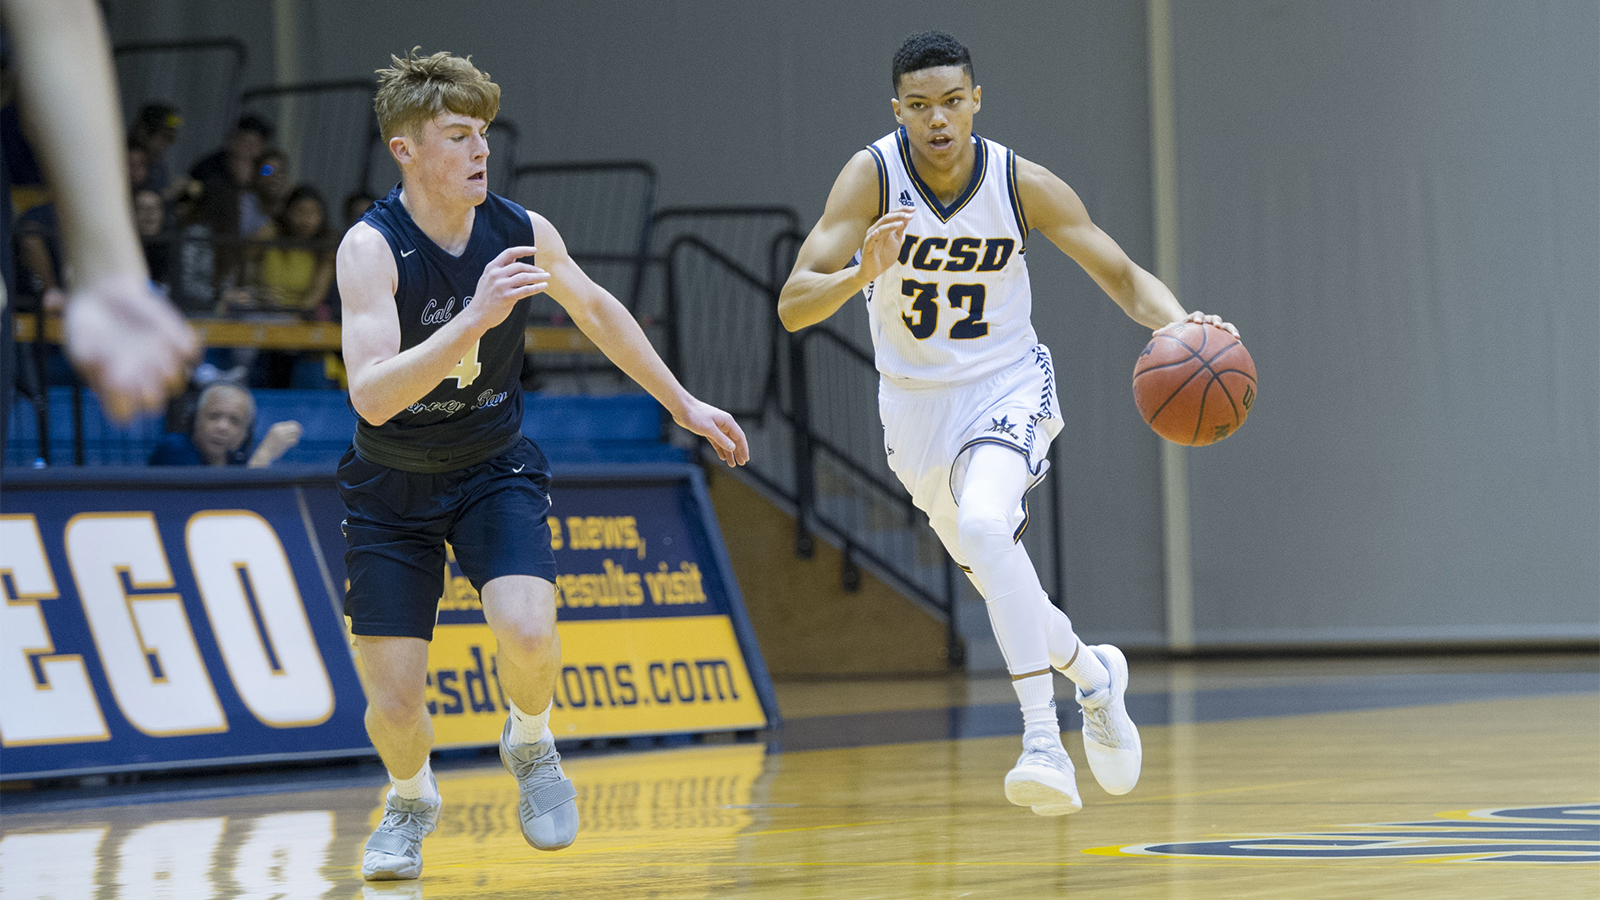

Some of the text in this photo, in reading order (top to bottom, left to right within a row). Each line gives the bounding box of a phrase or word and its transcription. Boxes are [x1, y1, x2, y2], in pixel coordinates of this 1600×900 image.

[420, 296, 456, 326] Cal
[901, 277, 990, 341] 32
[556, 558, 707, 608] results visit
[0, 509, 336, 748] EGO
